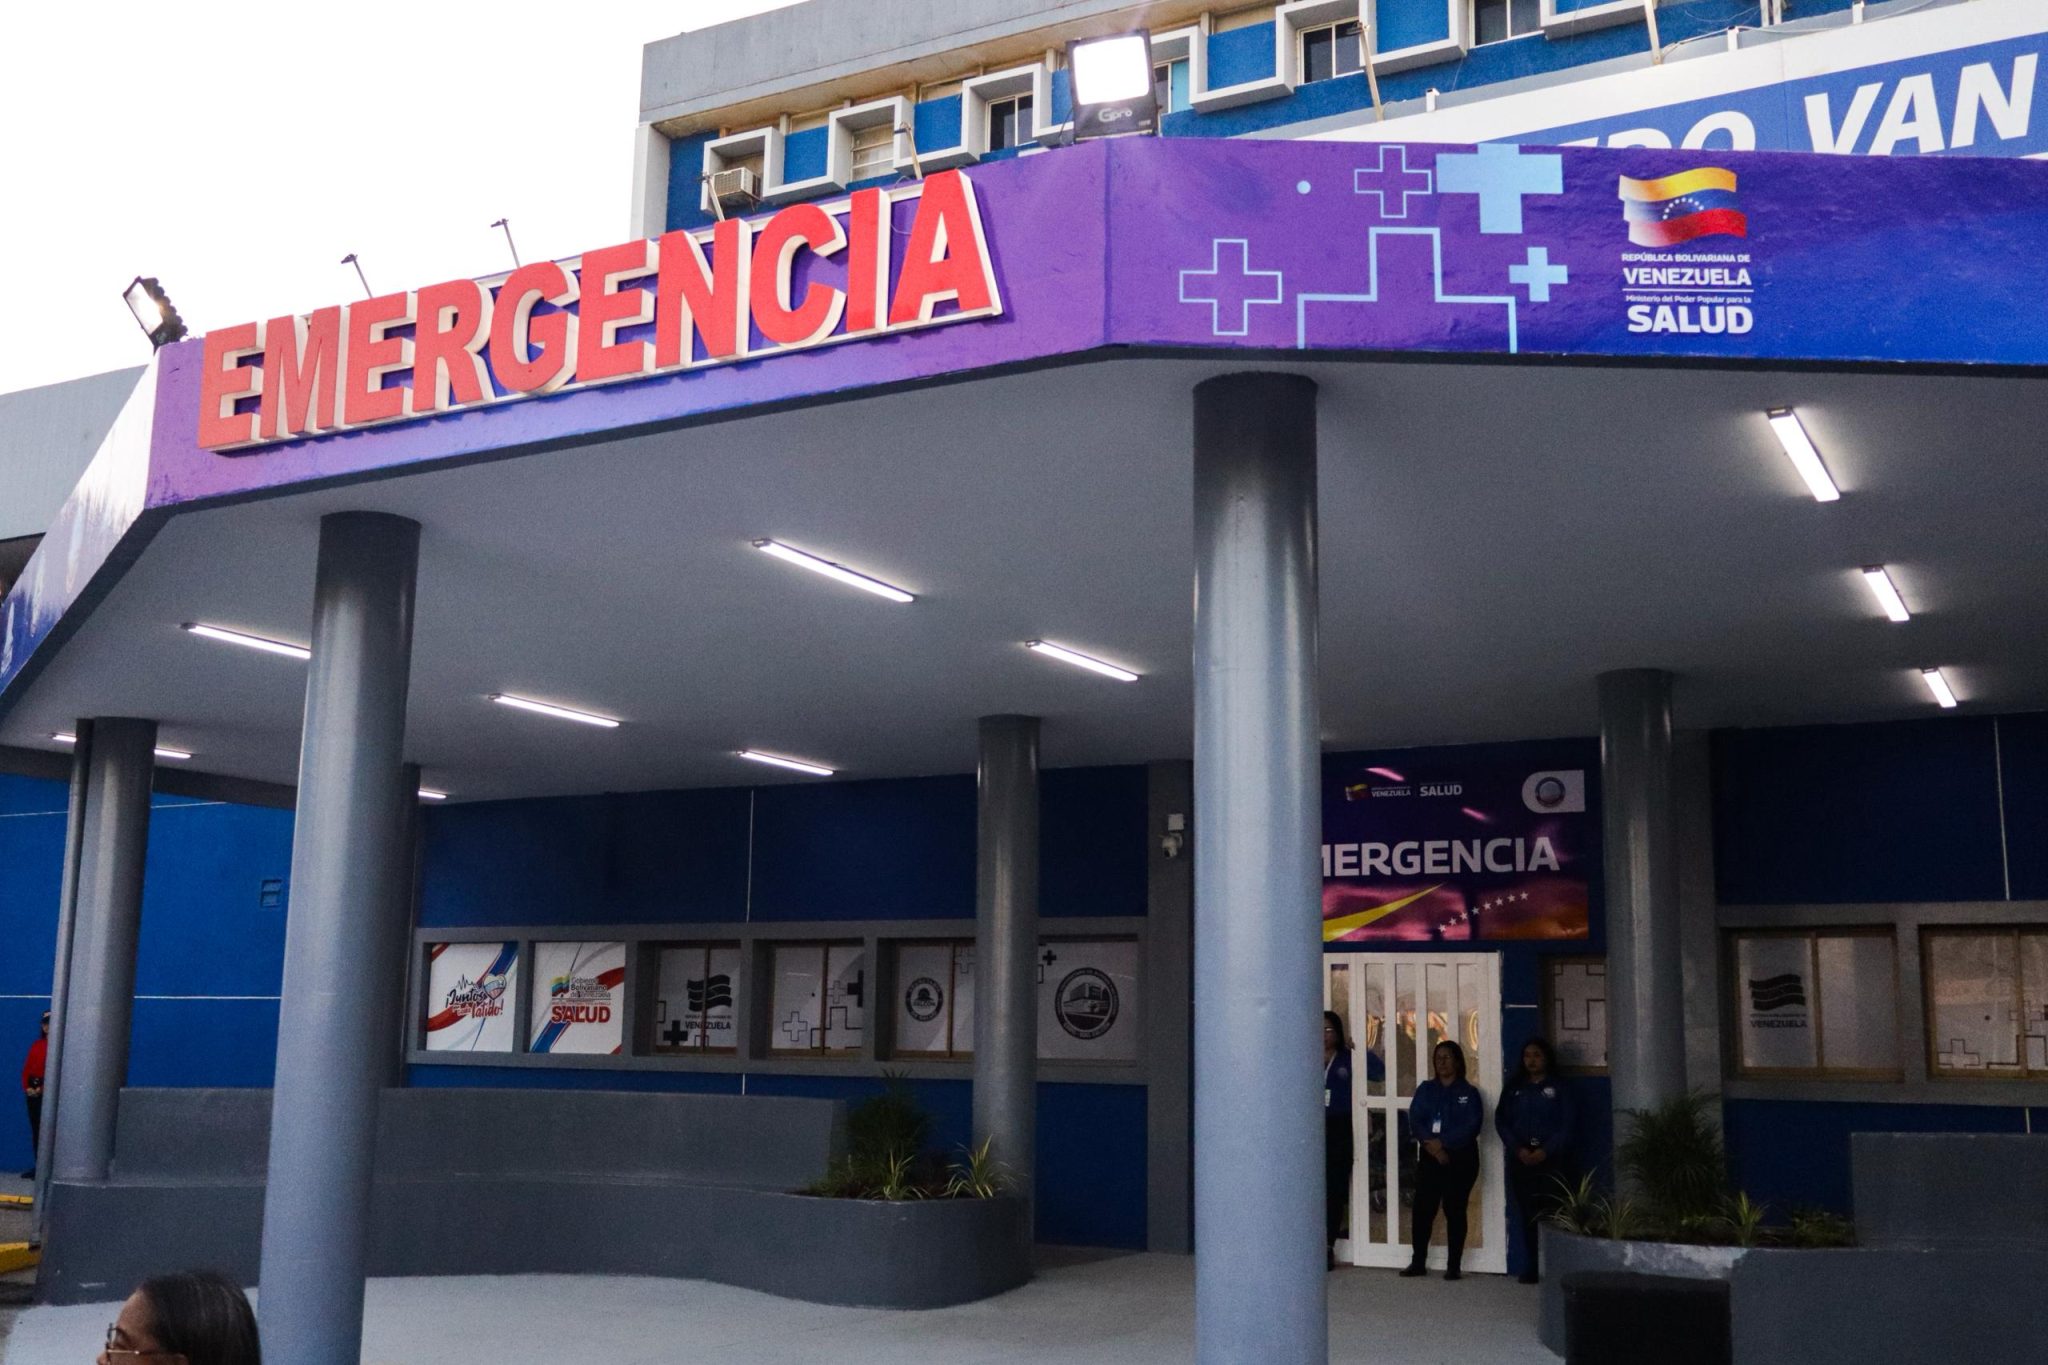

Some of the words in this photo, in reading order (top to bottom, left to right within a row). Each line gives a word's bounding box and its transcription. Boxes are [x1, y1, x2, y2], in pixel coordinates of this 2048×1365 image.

[1804, 53, 2038, 155] VAN
[1621, 252, 1673, 262] REPÚBLICA
[1675, 254, 1735, 263] BOLIVARIANA
[1738, 254, 1751, 263] DE
[1622, 267, 1752, 286] VENEZUELA
[1626, 294, 1661, 303] Ministerio
[1662, 295, 1673, 303] del
[1674, 295, 1696, 303] Poder
[1698, 295, 1725, 305] Popular
[1726, 297, 1743, 305] para
[1744, 296, 1752, 304] la
[199, 168, 1003, 451] EMERGENCIA
[1627, 304, 1753, 334] SALUD
[1371, 788, 1412, 798] VENEZUELA
[1419, 784, 1463, 797] SALUD
[551, 1005, 611, 1023] SALUD
[685, 1021, 731, 1030] VENZUELA
[1750, 1020, 1808, 1029] VENEZUELA
